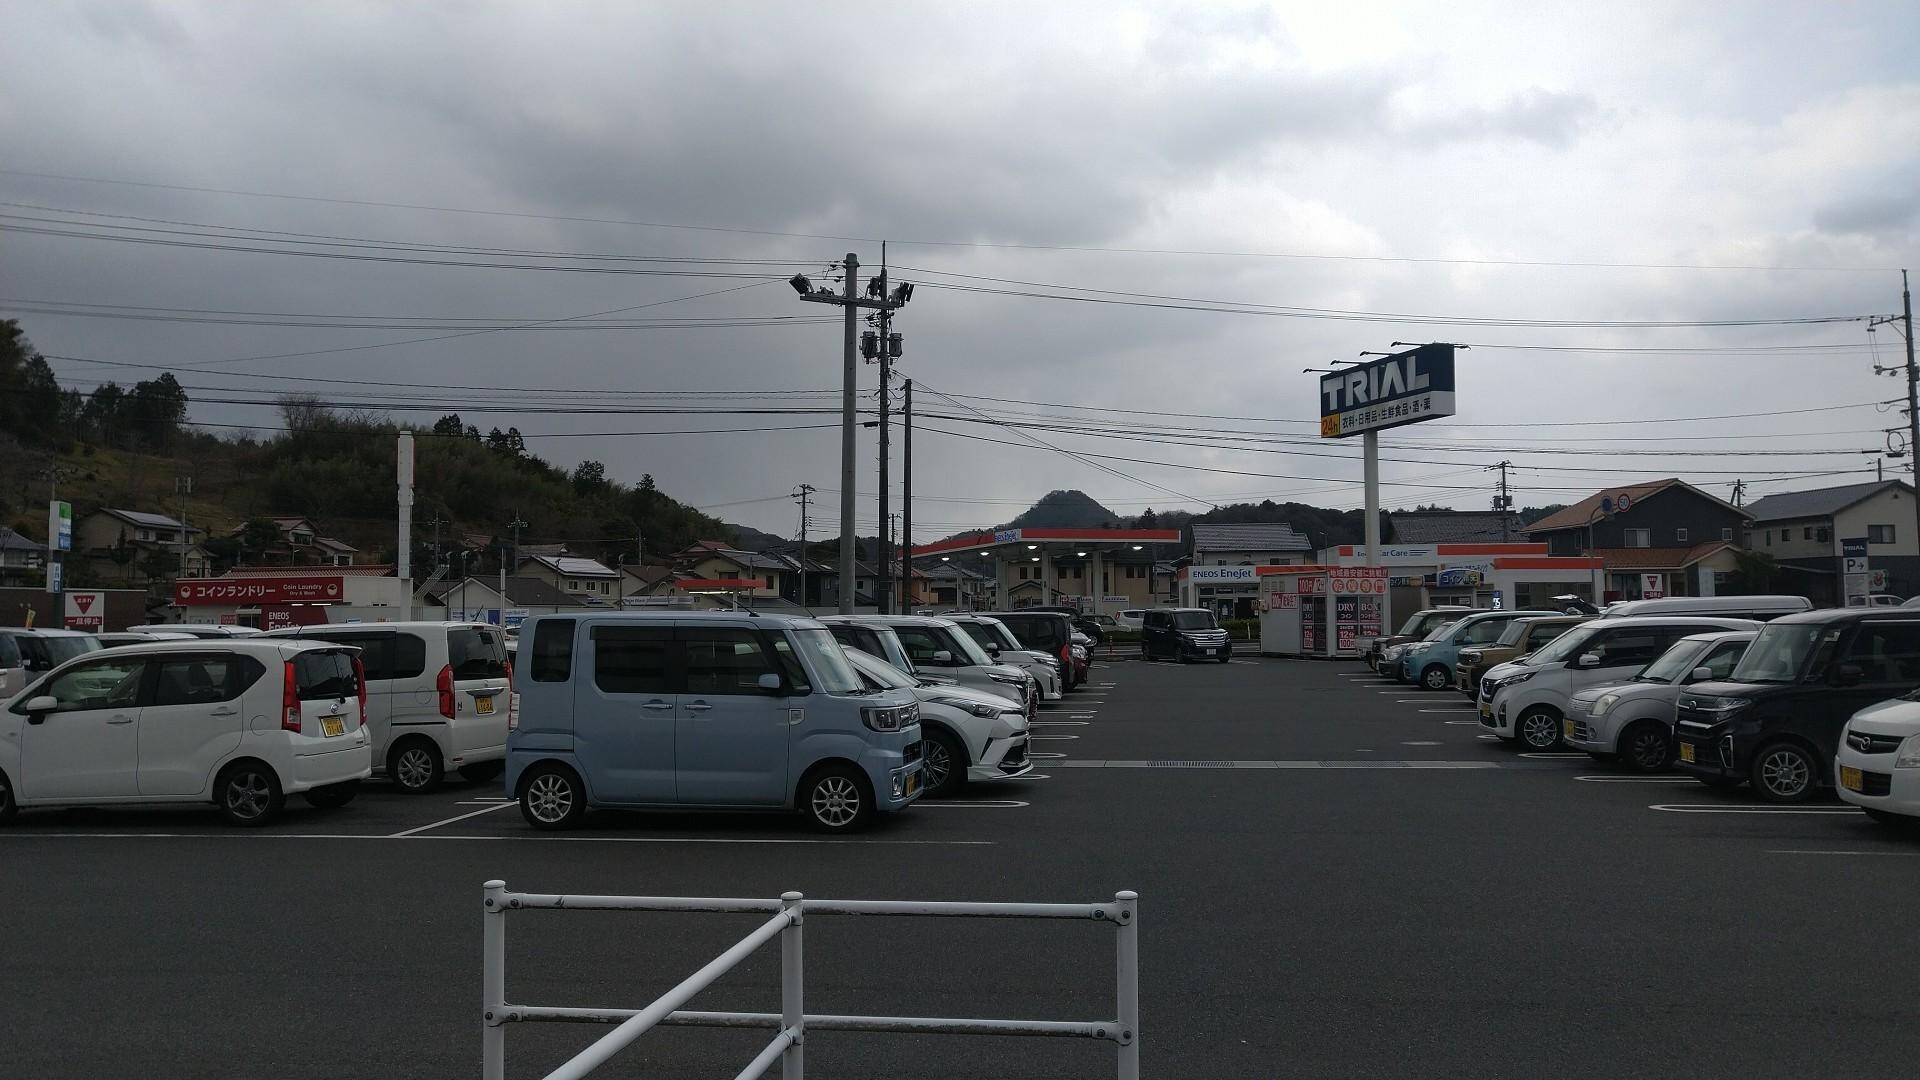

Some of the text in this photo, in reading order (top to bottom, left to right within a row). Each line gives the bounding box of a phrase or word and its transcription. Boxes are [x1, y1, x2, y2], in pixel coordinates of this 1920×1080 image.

[1322, 356, 1430, 411] TRIAL
[1322, 420, 1338, 435] 24h
[1847, 559, 1856, 572] P
[196, 585, 276, 597] コインランドリー
[298, 584, 323, 592] Laundry
[1337, 603, 1379, 611] DRY BOX
[268, 611, 290, 620] ENEOS
[1339, 630, 1355, 639] 12分
